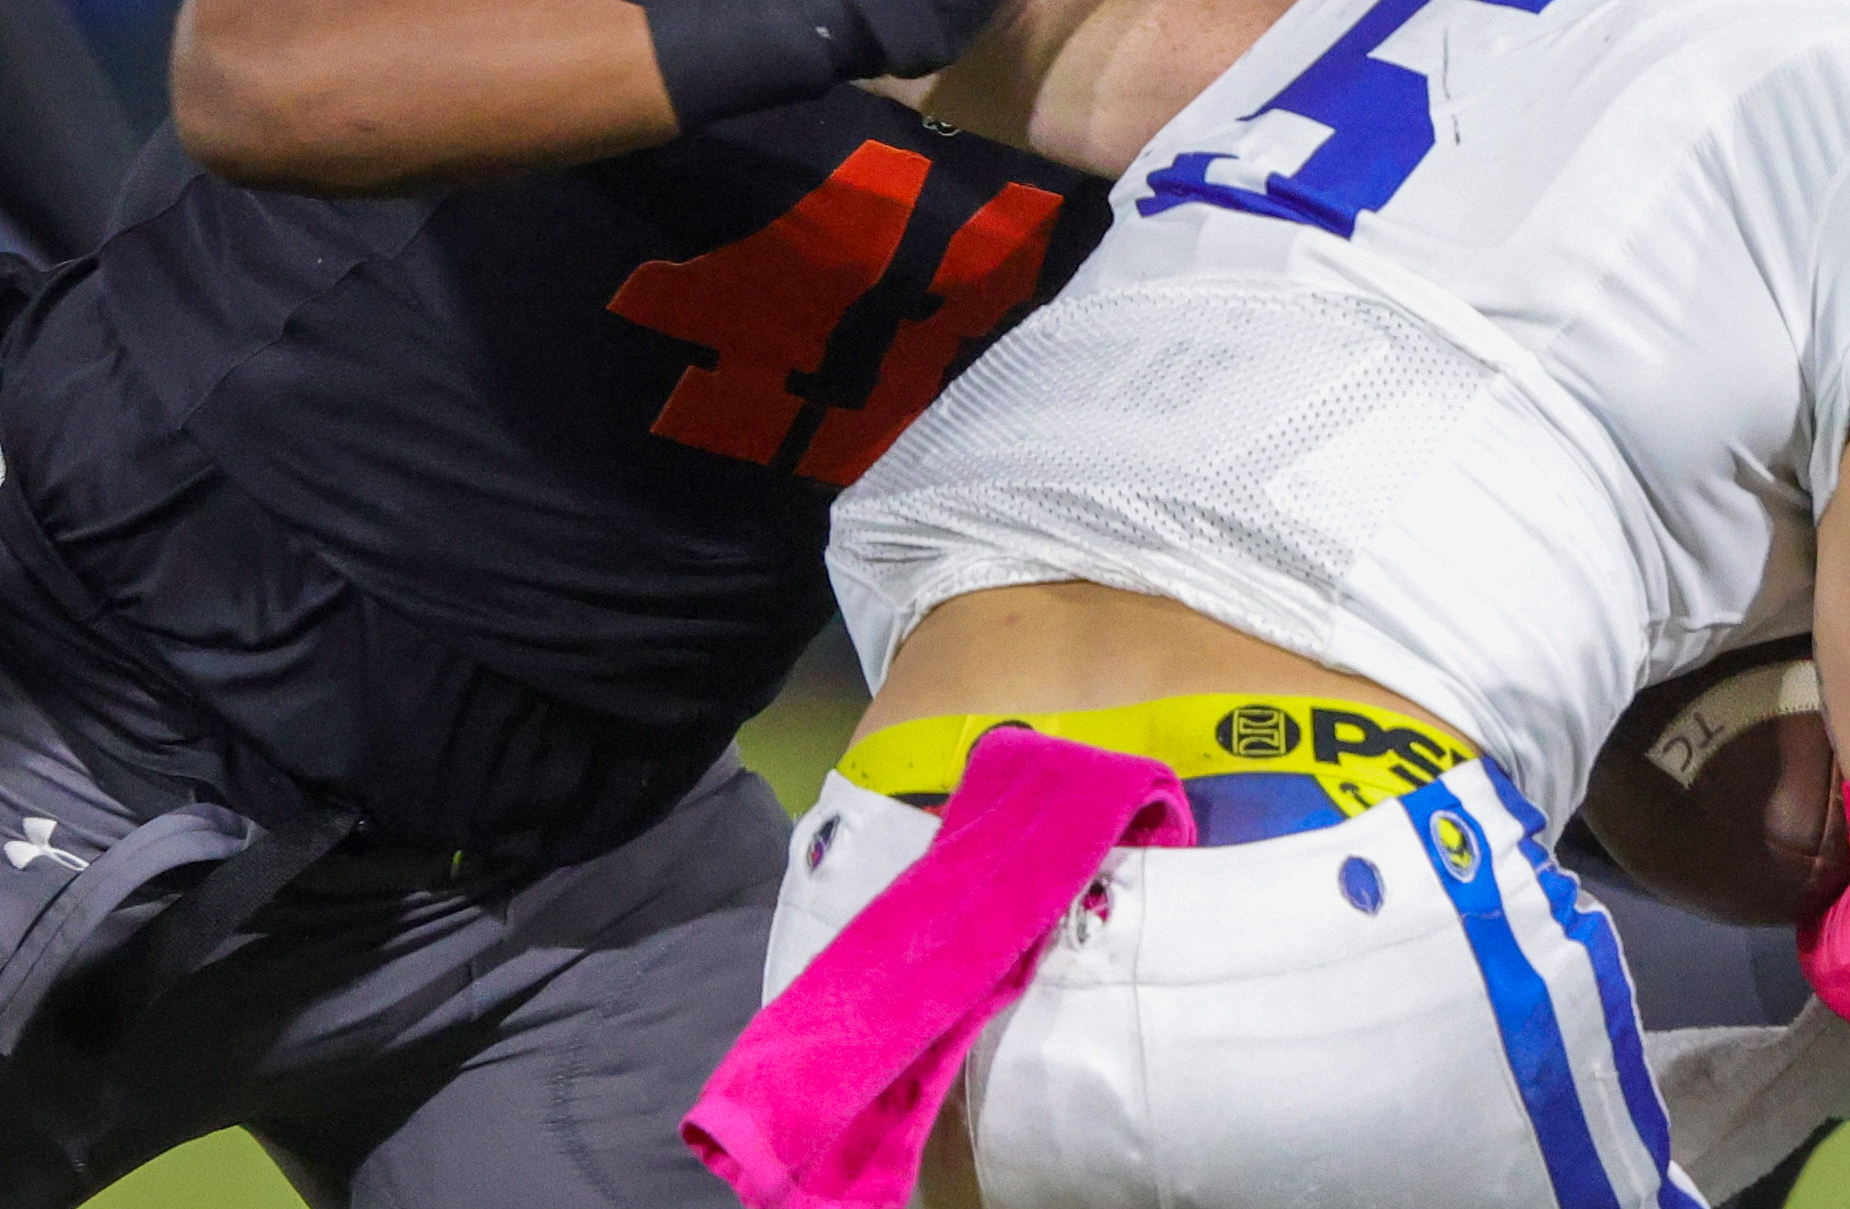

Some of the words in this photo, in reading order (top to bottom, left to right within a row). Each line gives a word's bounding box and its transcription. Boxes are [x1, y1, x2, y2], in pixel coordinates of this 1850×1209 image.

[606, 139, 1065, 488] 41
[1310, 706, 1469, 790] PS
[1662, 711, 1725, 774] TC
